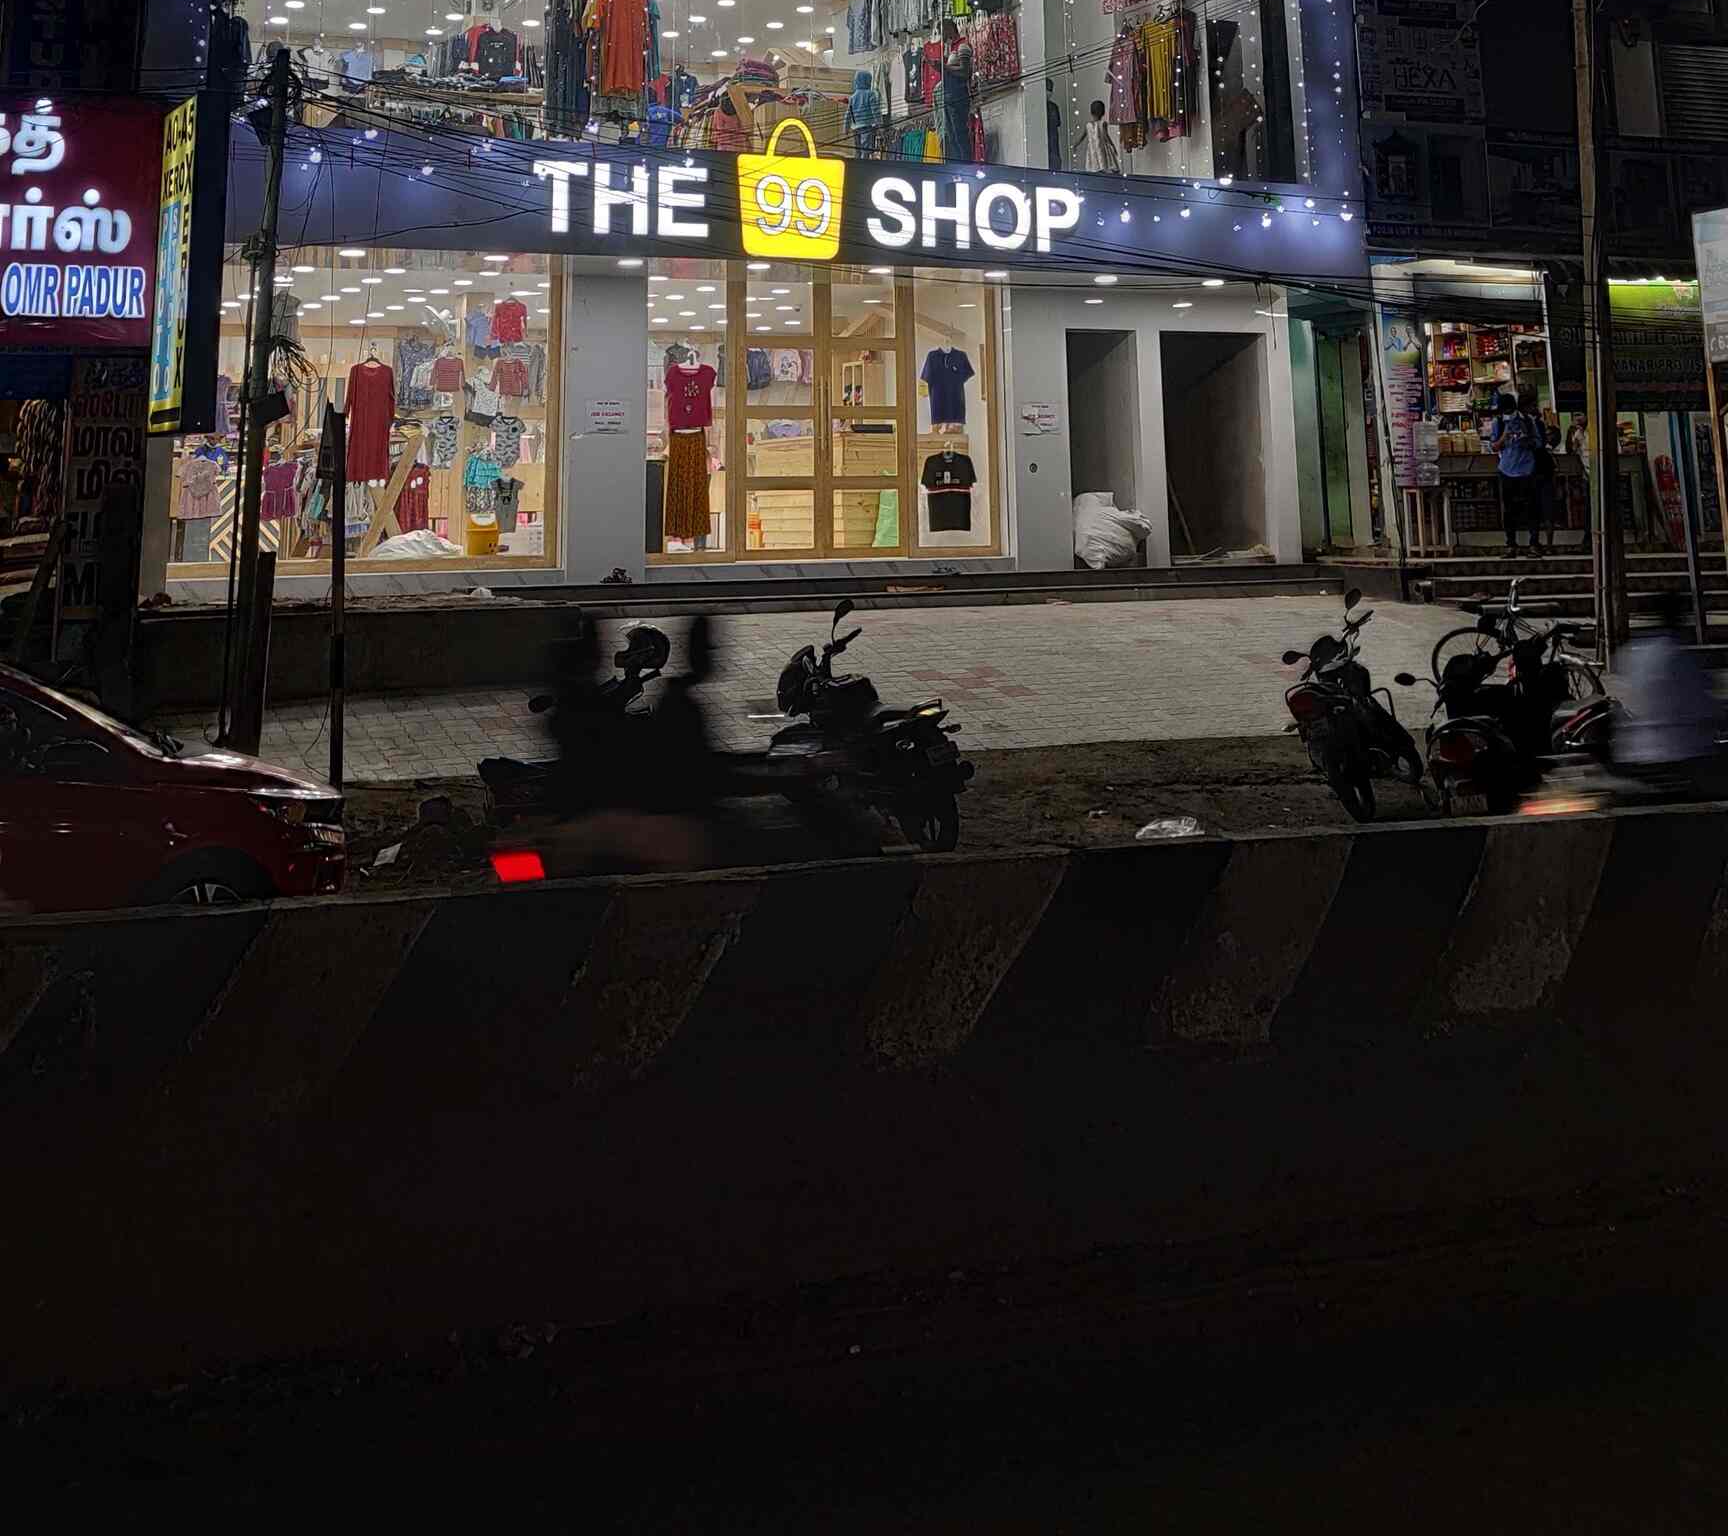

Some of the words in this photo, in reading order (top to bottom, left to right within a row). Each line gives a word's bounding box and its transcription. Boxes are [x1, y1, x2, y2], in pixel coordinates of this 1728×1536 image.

[161, 150, 194, 202] XEROX
[533, 160, 709, 238] THE
[754, 174, 833, 238] 99
[865, 176, 1082, 253] SHOP
[2, 263, 60, 317] OMR
[63, 265, 146, 317] PADUR
